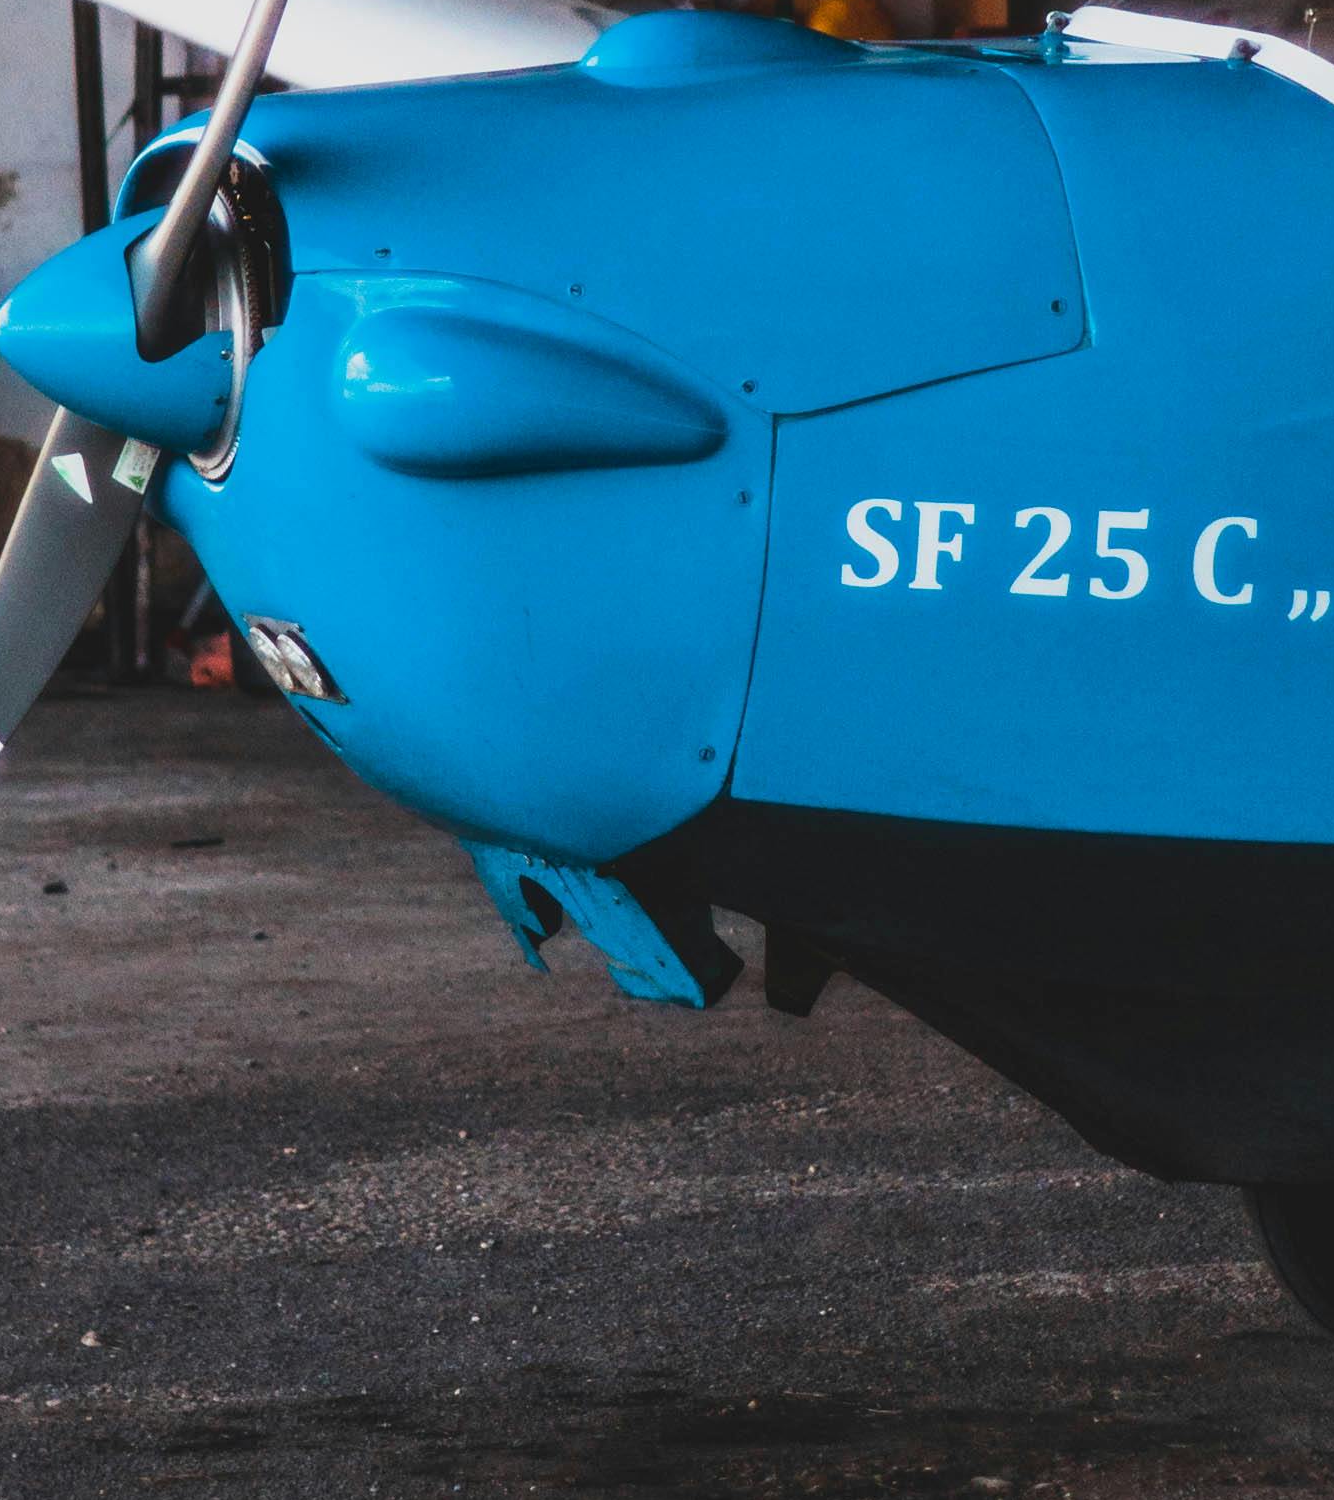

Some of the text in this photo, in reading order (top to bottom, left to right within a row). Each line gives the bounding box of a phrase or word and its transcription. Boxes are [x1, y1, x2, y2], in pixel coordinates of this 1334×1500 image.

[840, 497, 976, 591] SF
[1008, 505, 1151, 601] 25
[1192, 515, 1259, 606] C
